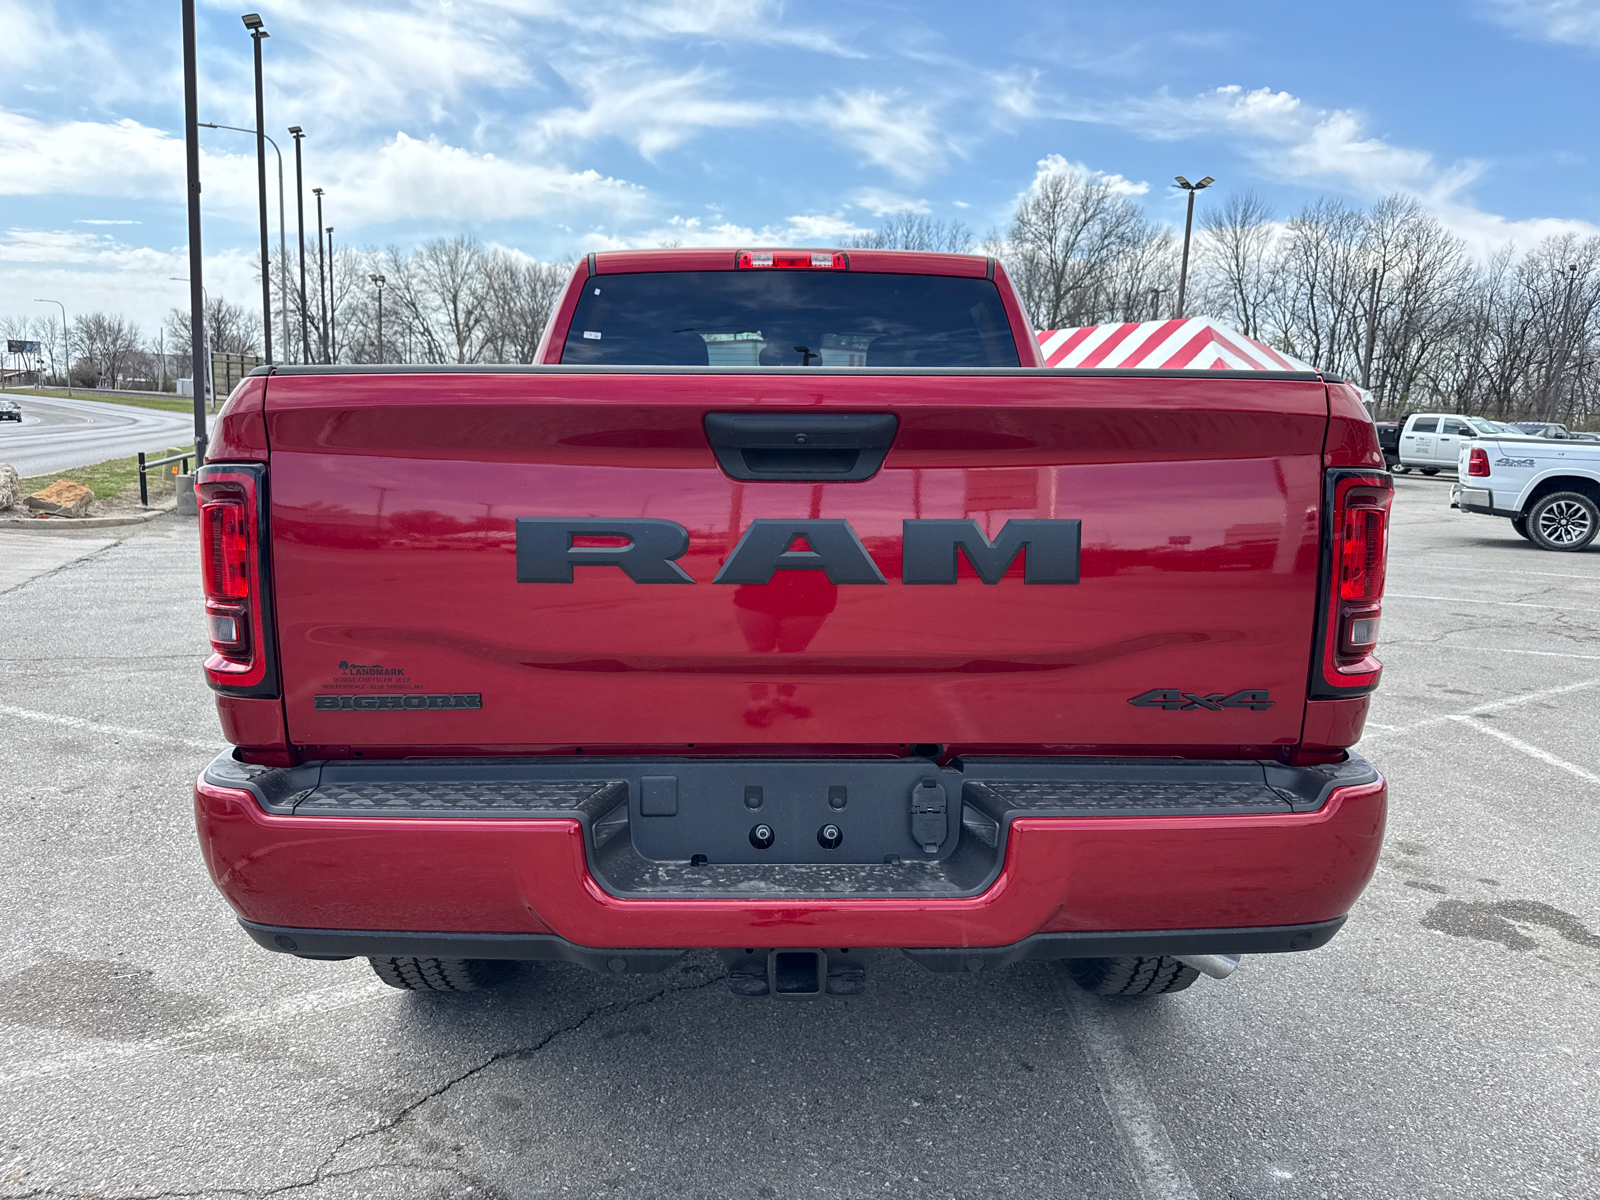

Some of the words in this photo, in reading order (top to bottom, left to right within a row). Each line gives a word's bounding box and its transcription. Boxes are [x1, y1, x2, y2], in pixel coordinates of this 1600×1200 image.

[515, 516, 1082, 585] RAM
[349, 668, 405, 676] LANDMARK
[314, 693, 482, 711] BIGHORN
